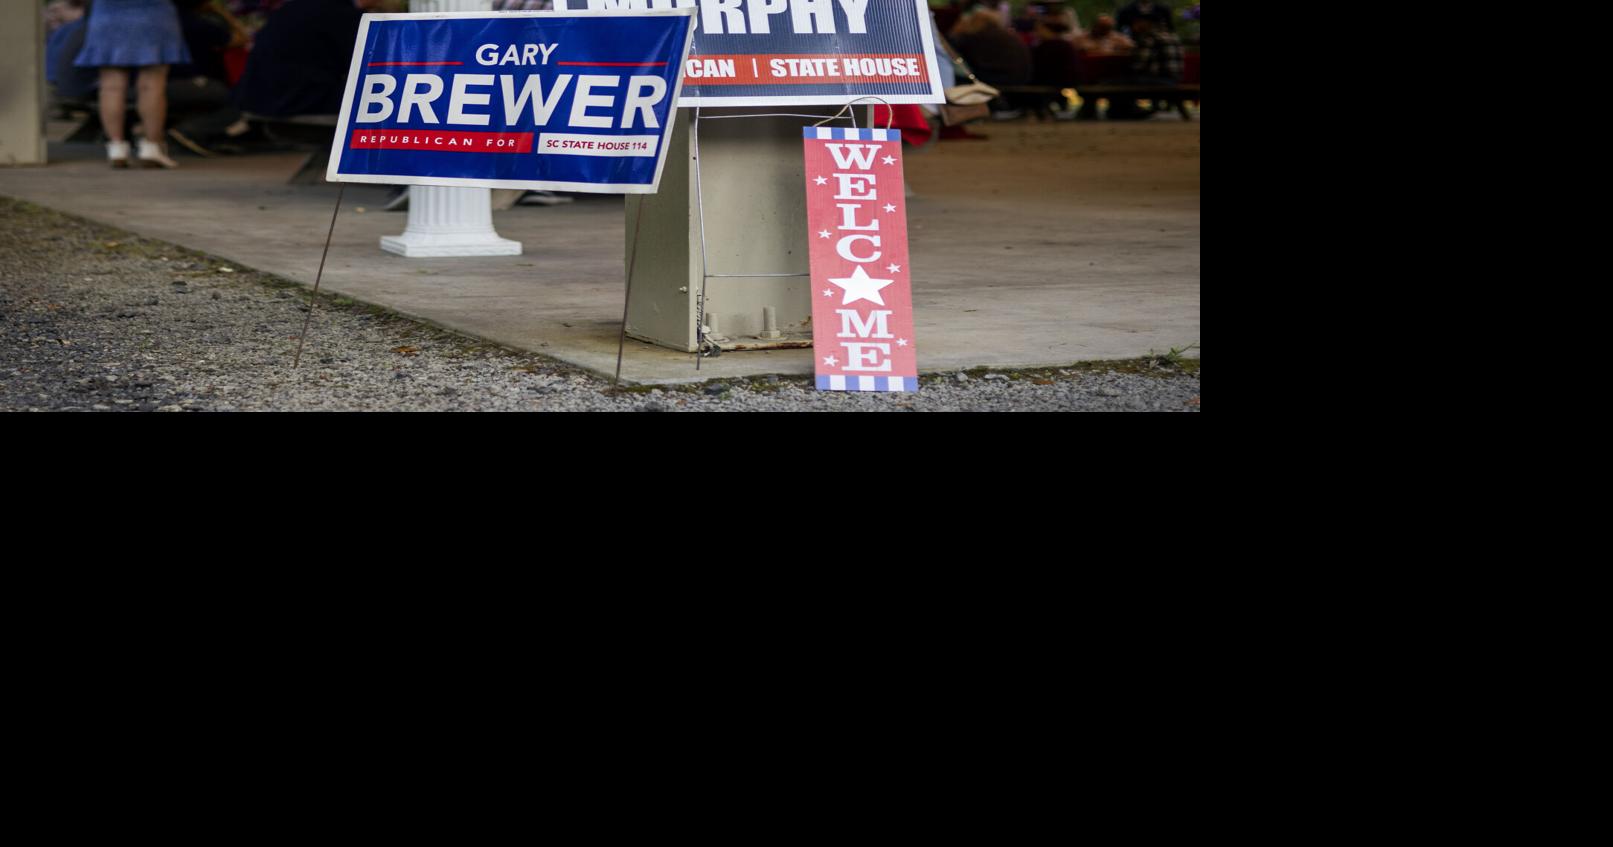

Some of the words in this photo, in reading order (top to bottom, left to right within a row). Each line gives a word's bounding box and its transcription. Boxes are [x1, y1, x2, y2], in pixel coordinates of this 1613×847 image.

[588, 0, 868, 34] RPHY
[475, 43, 559, 66] GARY
[683, 58, 736, 78] CAN
[770, 58, 841, 78] STATE
[843, 57, 920, 76] HOUSE
[355, 73, 668, 129] BREWER
[360, 135, 473, 146] REPUBLICAN
[486, 138, 515, 147] FOR
[546, 139, 559, 148] SC
[562, 140, 594, 150] STATE
[597, 141, 630, 150] HOUSE
[632, 142, 648, 150] 114
